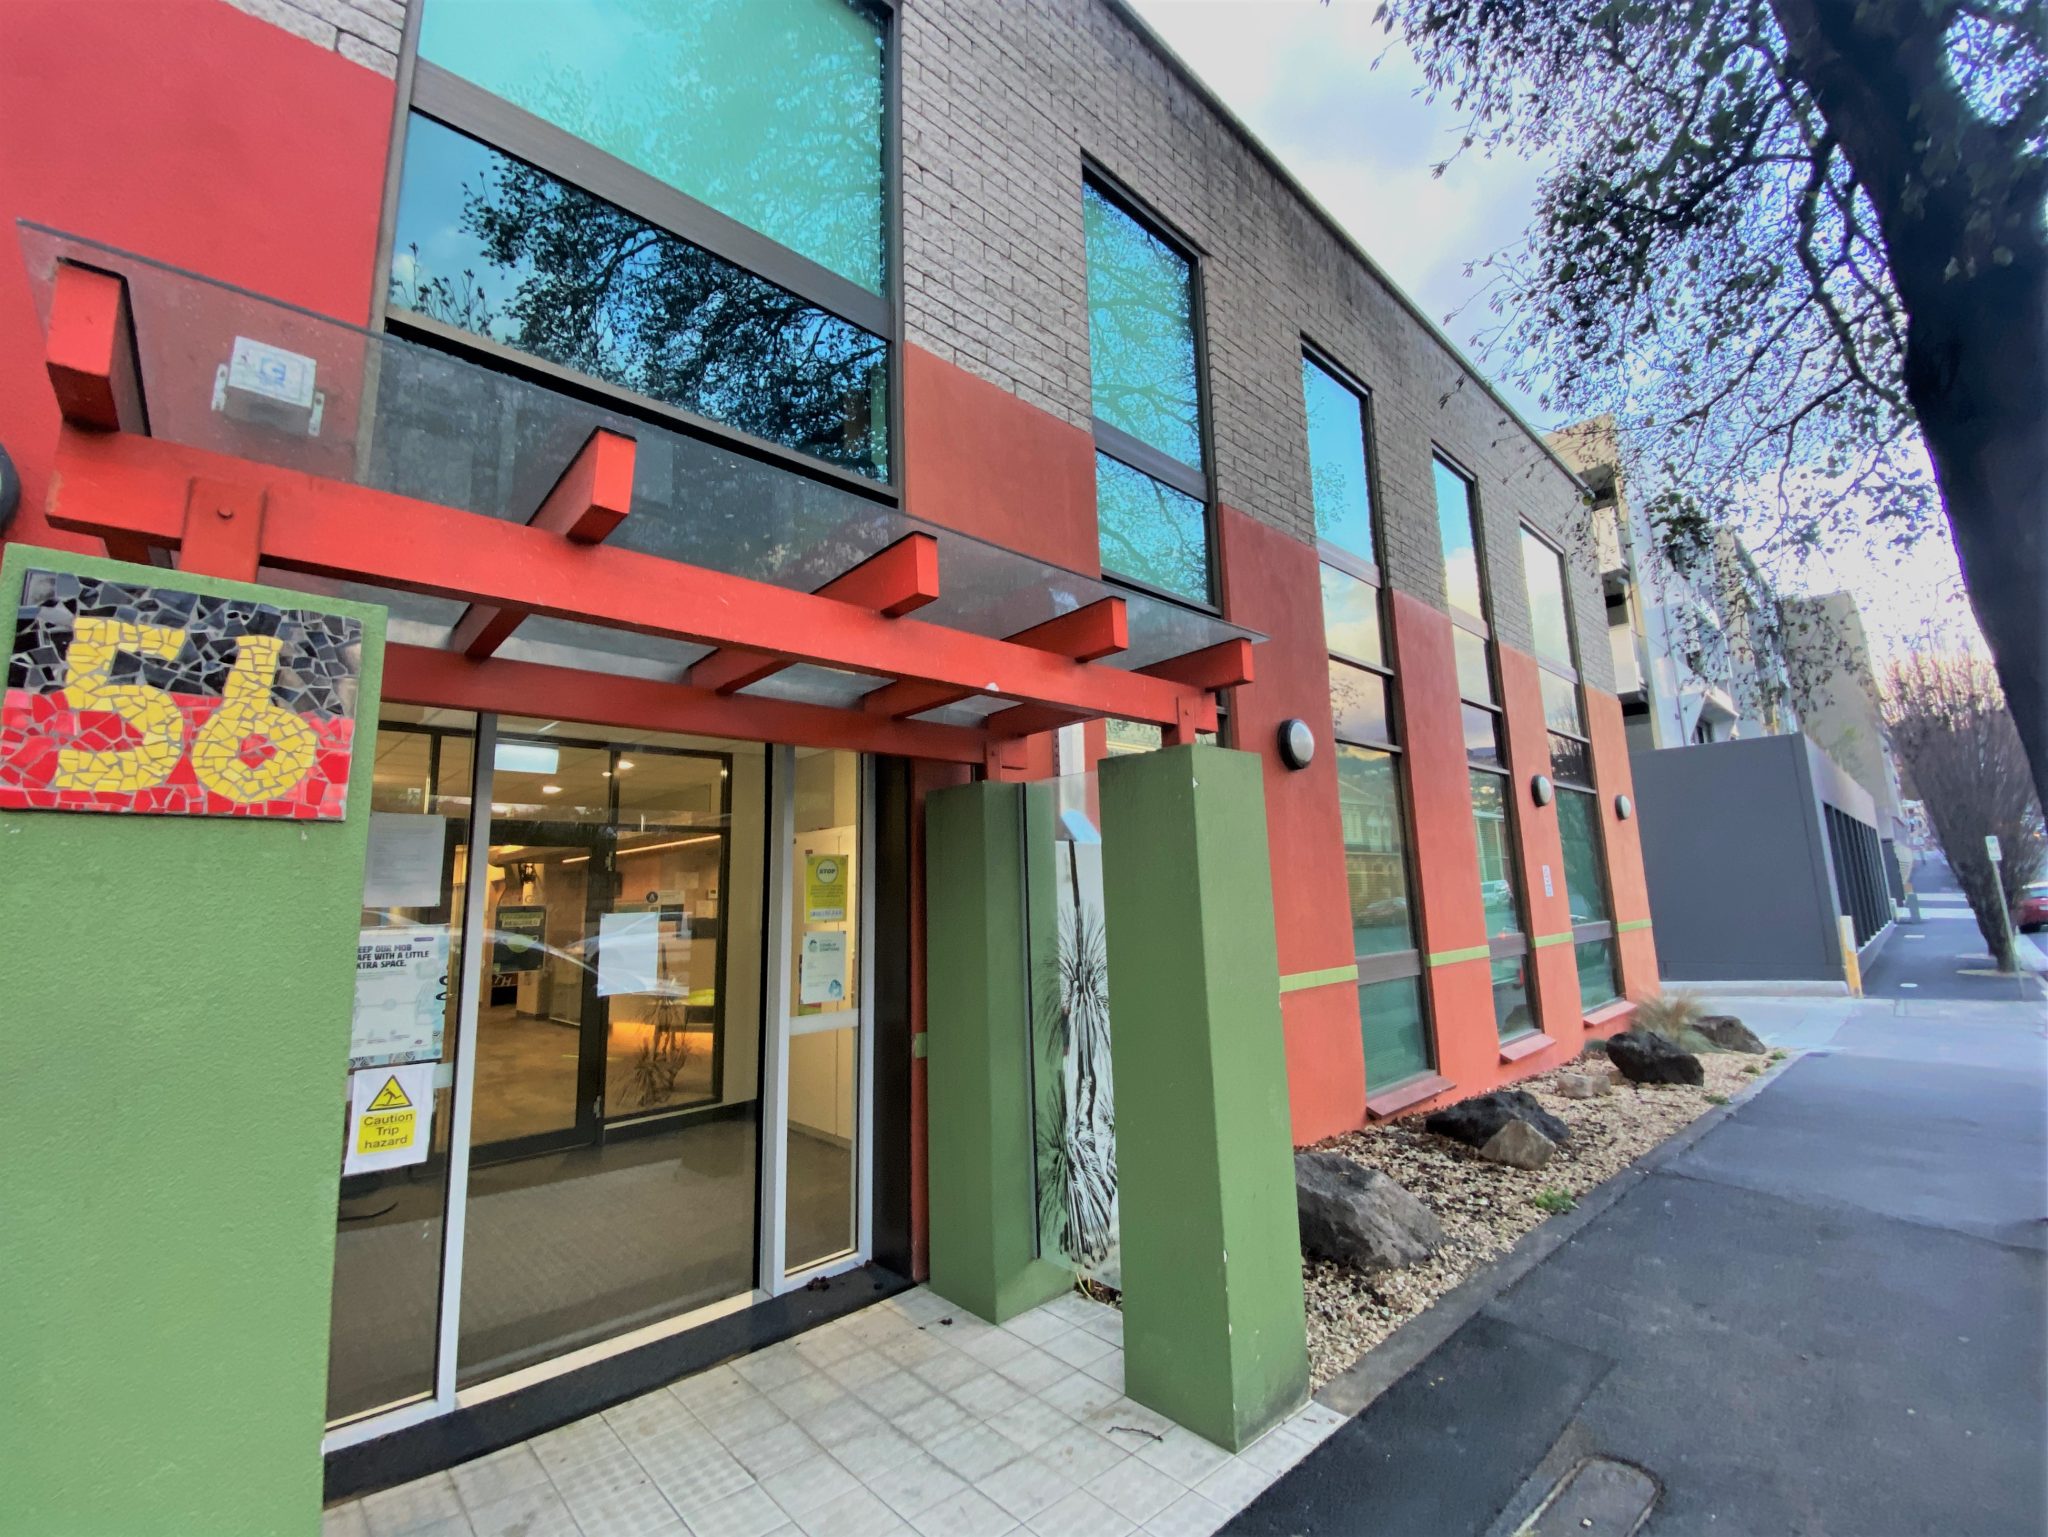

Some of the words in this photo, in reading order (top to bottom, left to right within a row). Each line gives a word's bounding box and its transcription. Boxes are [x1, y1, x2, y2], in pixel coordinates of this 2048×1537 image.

[56, 616, 317, 803] 56
[375, 945, 392, 953] OUR
[394, 944, 412, 952] MOB
[405, 950, 430, 959] LITTLE
[380, 960, 406, 968] SPACE.
[363, 1113, 413, 1126] Caution
[376, 1126, 400, 1136] Trip
[364, 1135, 408, 1149] hazard
